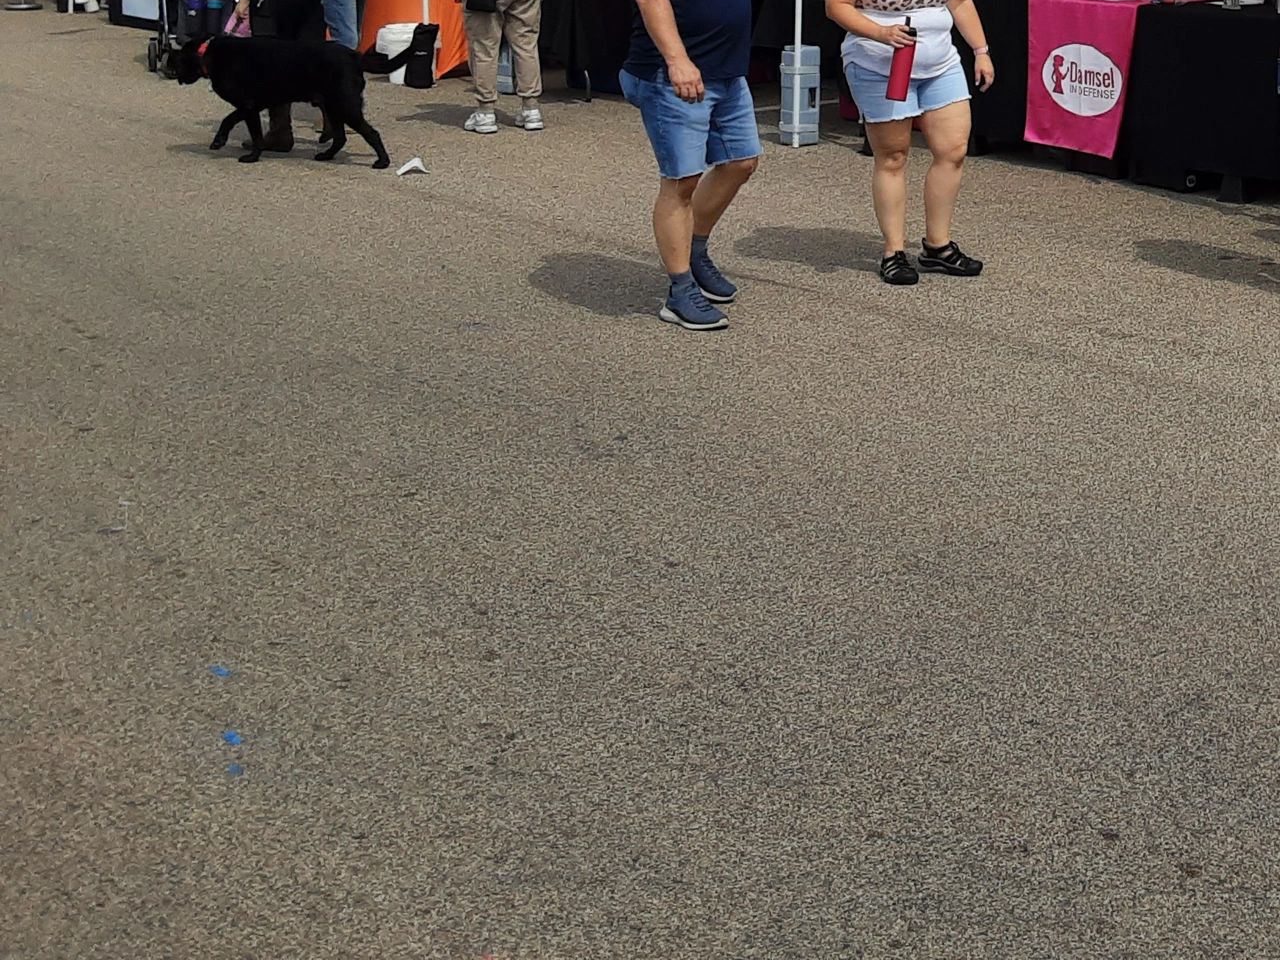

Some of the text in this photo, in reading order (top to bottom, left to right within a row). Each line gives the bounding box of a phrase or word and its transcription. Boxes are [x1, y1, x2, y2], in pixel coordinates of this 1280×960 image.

[1069, 61, 1115, 89] Damsel
[1069, 84, 1115, 100] IN DEFENSE
